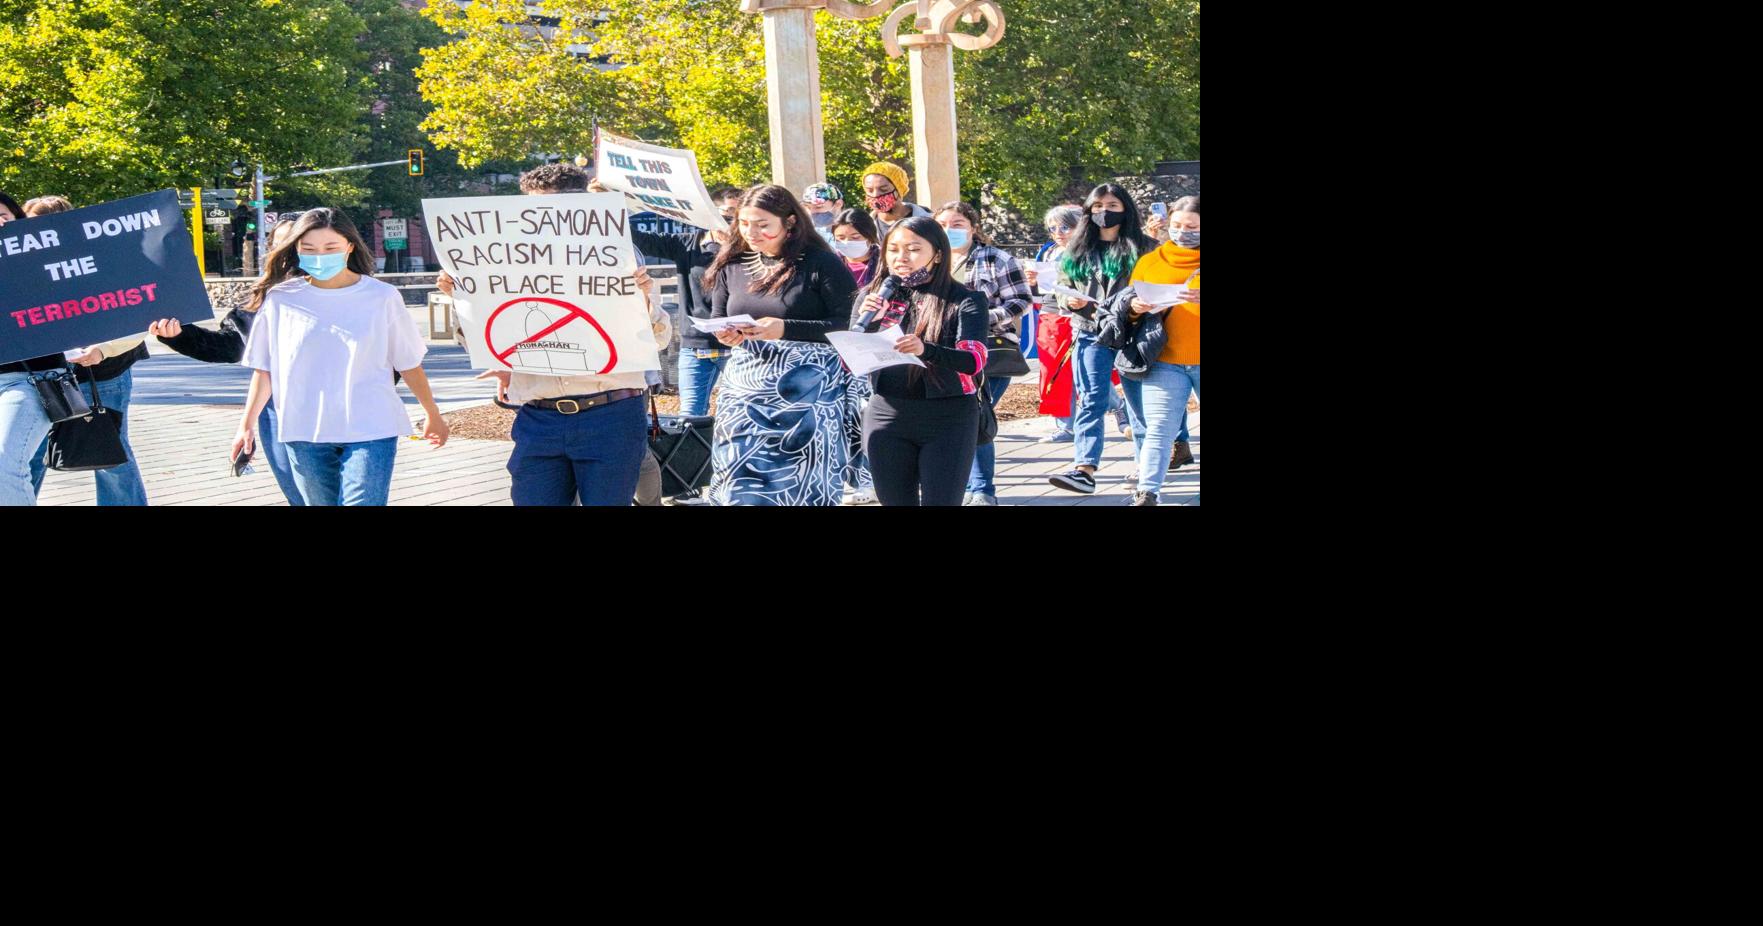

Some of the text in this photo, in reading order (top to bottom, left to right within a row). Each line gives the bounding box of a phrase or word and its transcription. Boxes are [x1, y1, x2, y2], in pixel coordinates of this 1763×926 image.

[607, 150, 673, 174] TELL THIS
[625, 175, 672, 192] TOWN
[0, 209, 162, 259] EAR DOWN
[44, 255, 98, 281] THE
[447, 242, 618, 270] RACISM HAS
[448, 274, 636, 296] NO PLACE HERE
[10, 283, 158, 328] TERRORIST
